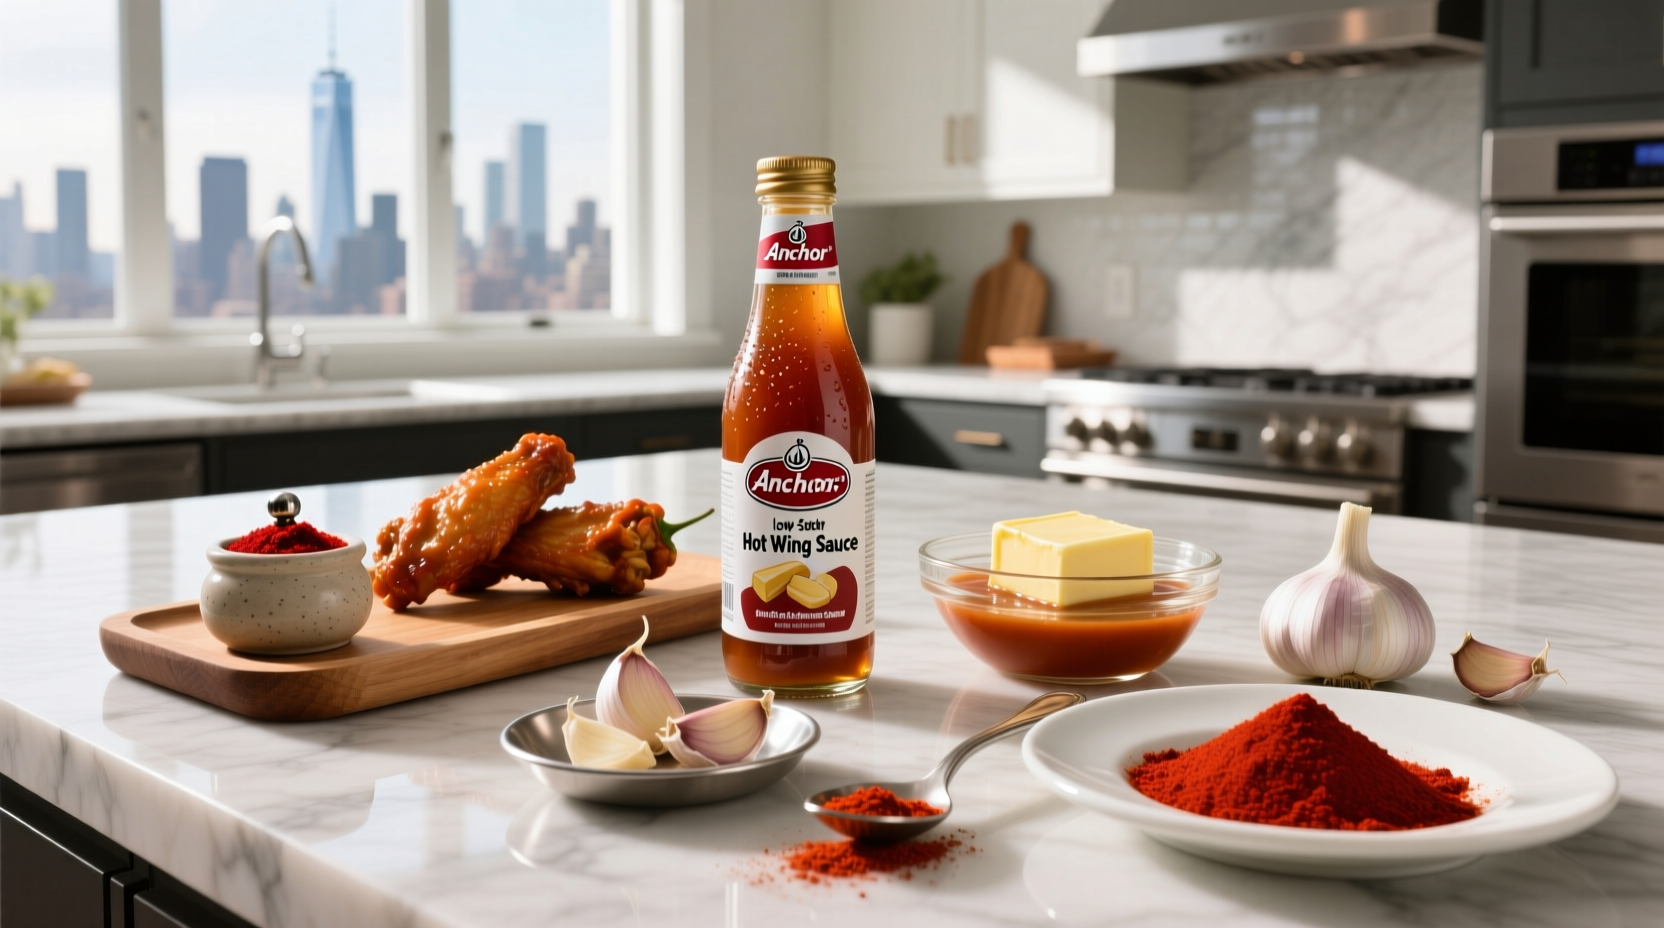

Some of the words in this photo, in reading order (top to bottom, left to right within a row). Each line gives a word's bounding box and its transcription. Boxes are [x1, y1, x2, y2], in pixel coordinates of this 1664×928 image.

[743, 532, 767, 552] Hot
[770, 534, 811, 558] Wing
[816, 534, 858, 553] Sauce
